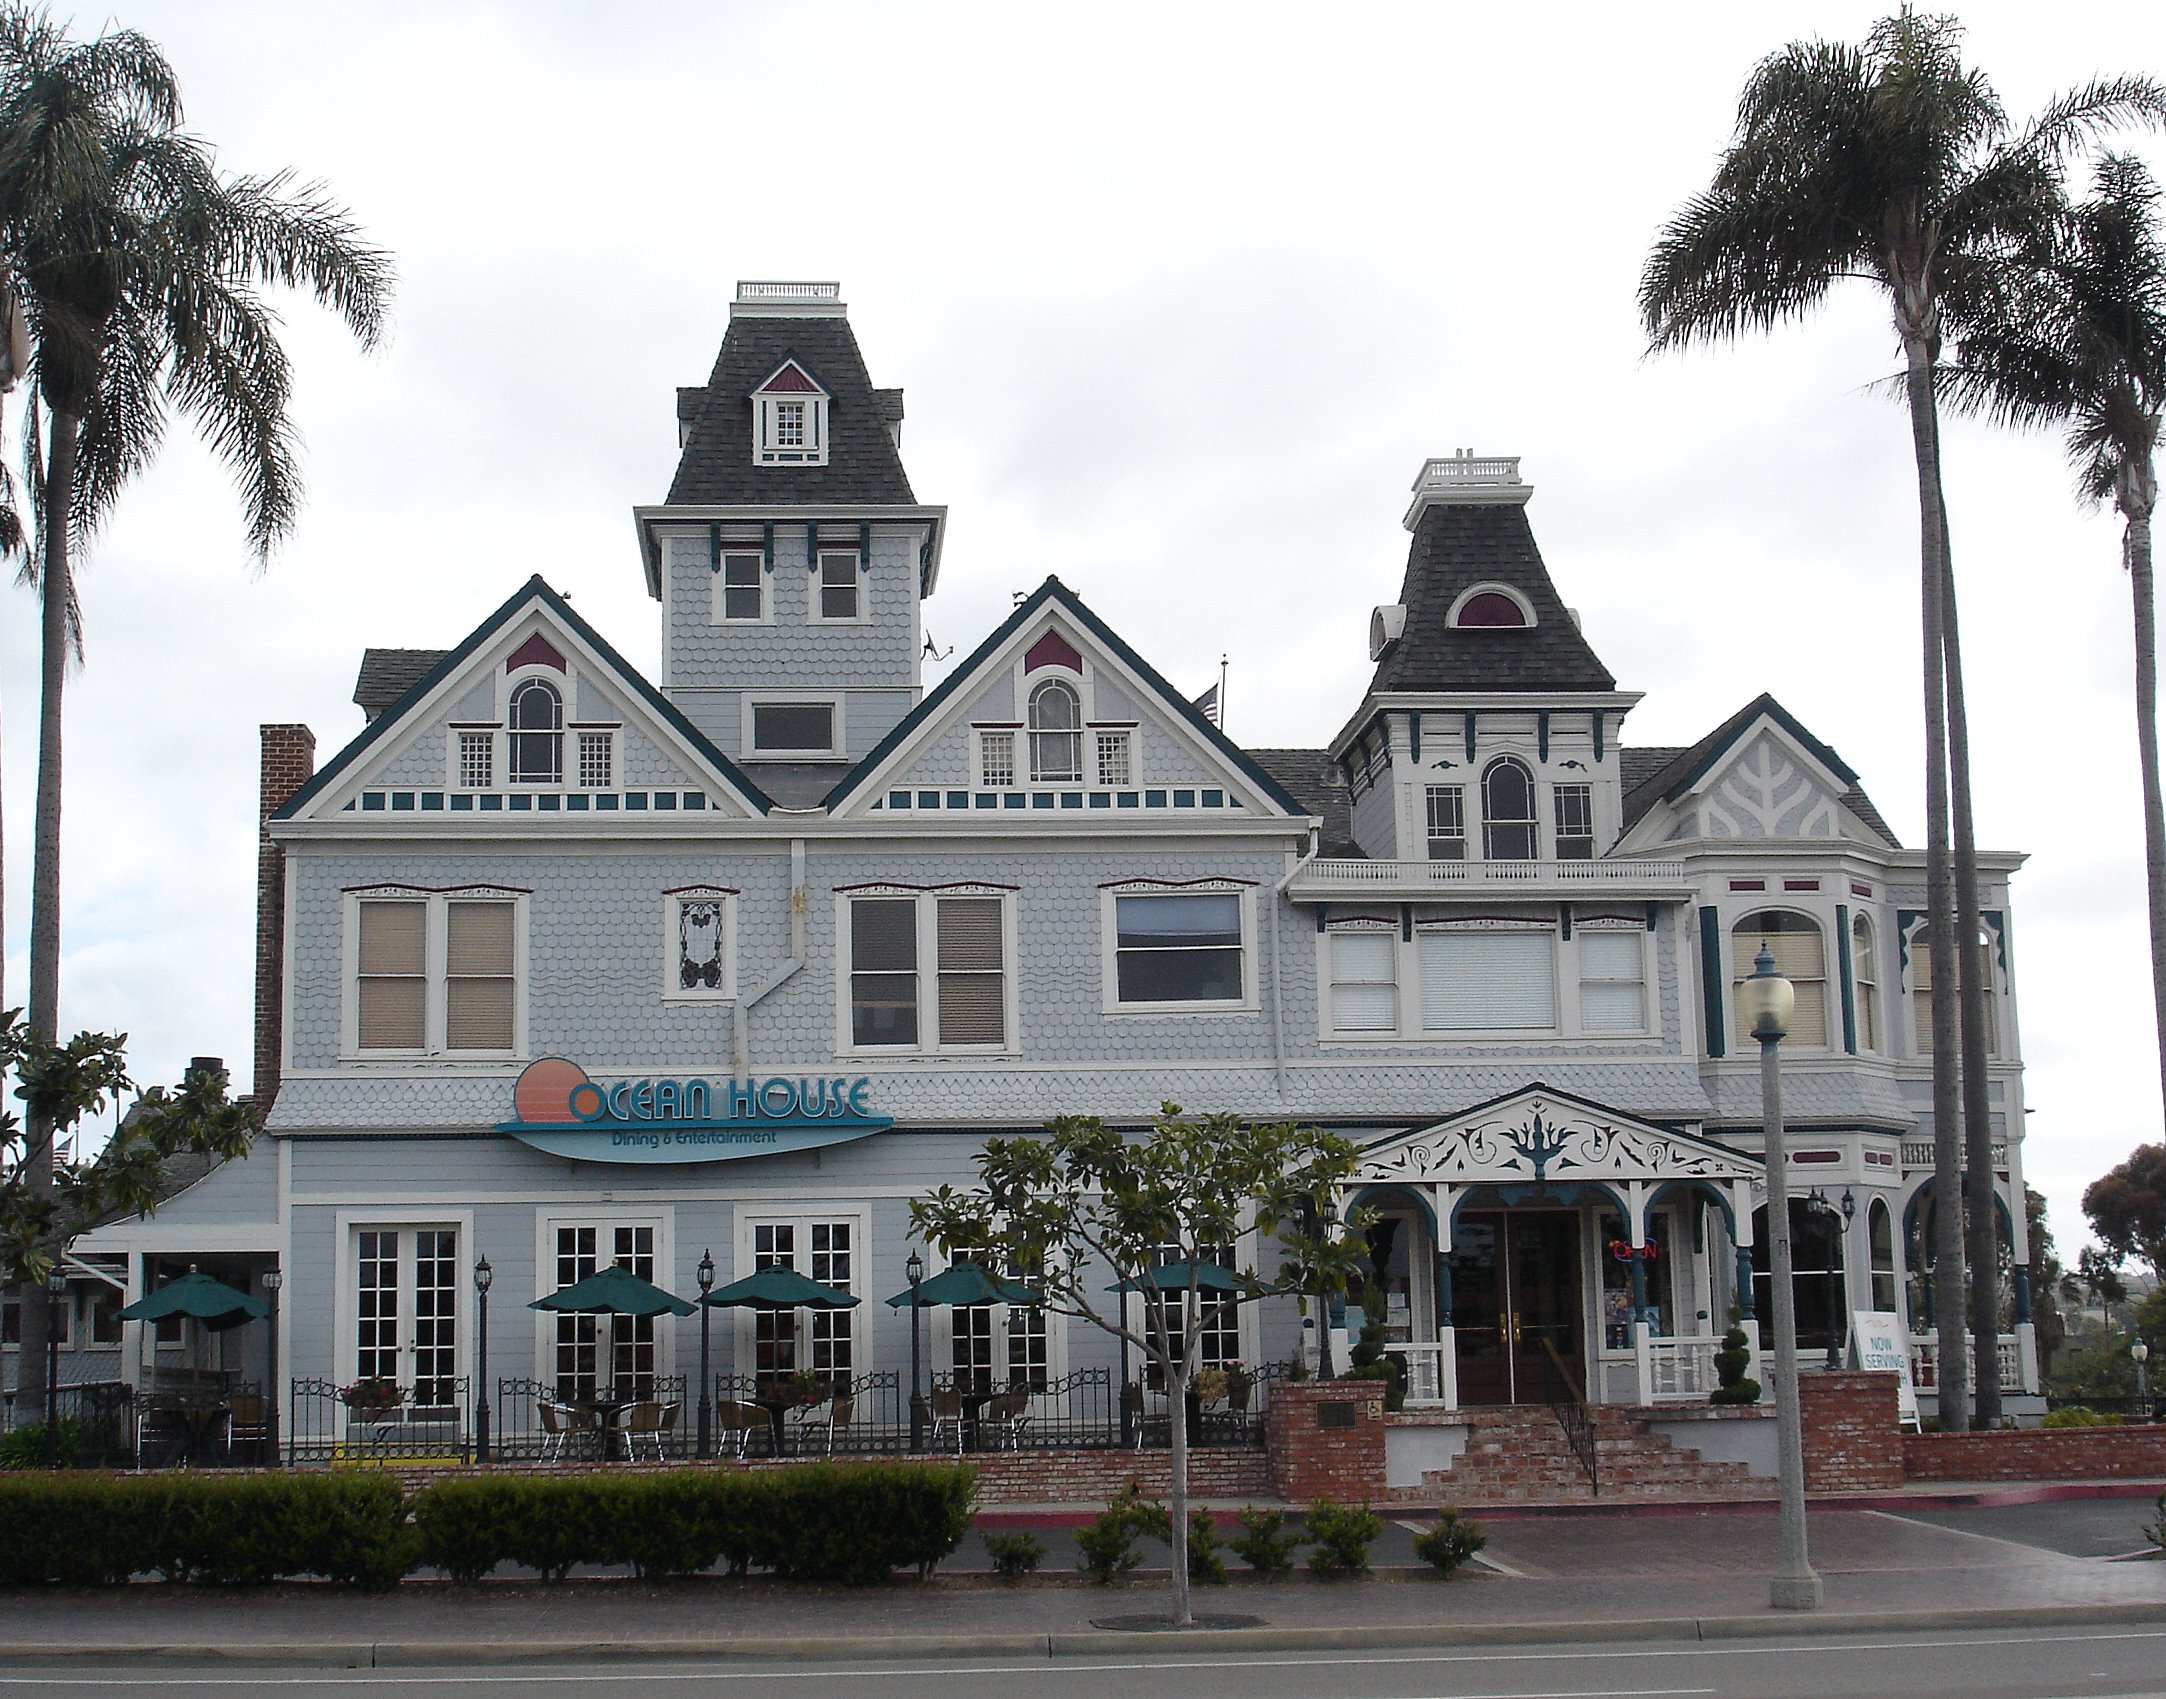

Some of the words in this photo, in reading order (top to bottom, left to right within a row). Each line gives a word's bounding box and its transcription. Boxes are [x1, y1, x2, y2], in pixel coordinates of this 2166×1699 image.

[613, 1132, 660, 1148] Dining
[675, 1130, 777, 1145] Entertainment
[1613, 1241, 1656, 1259] OPN
[1870, 1337, 1892, 1351] NOW
[1865, 1354, 1905, 1369] SERVING
